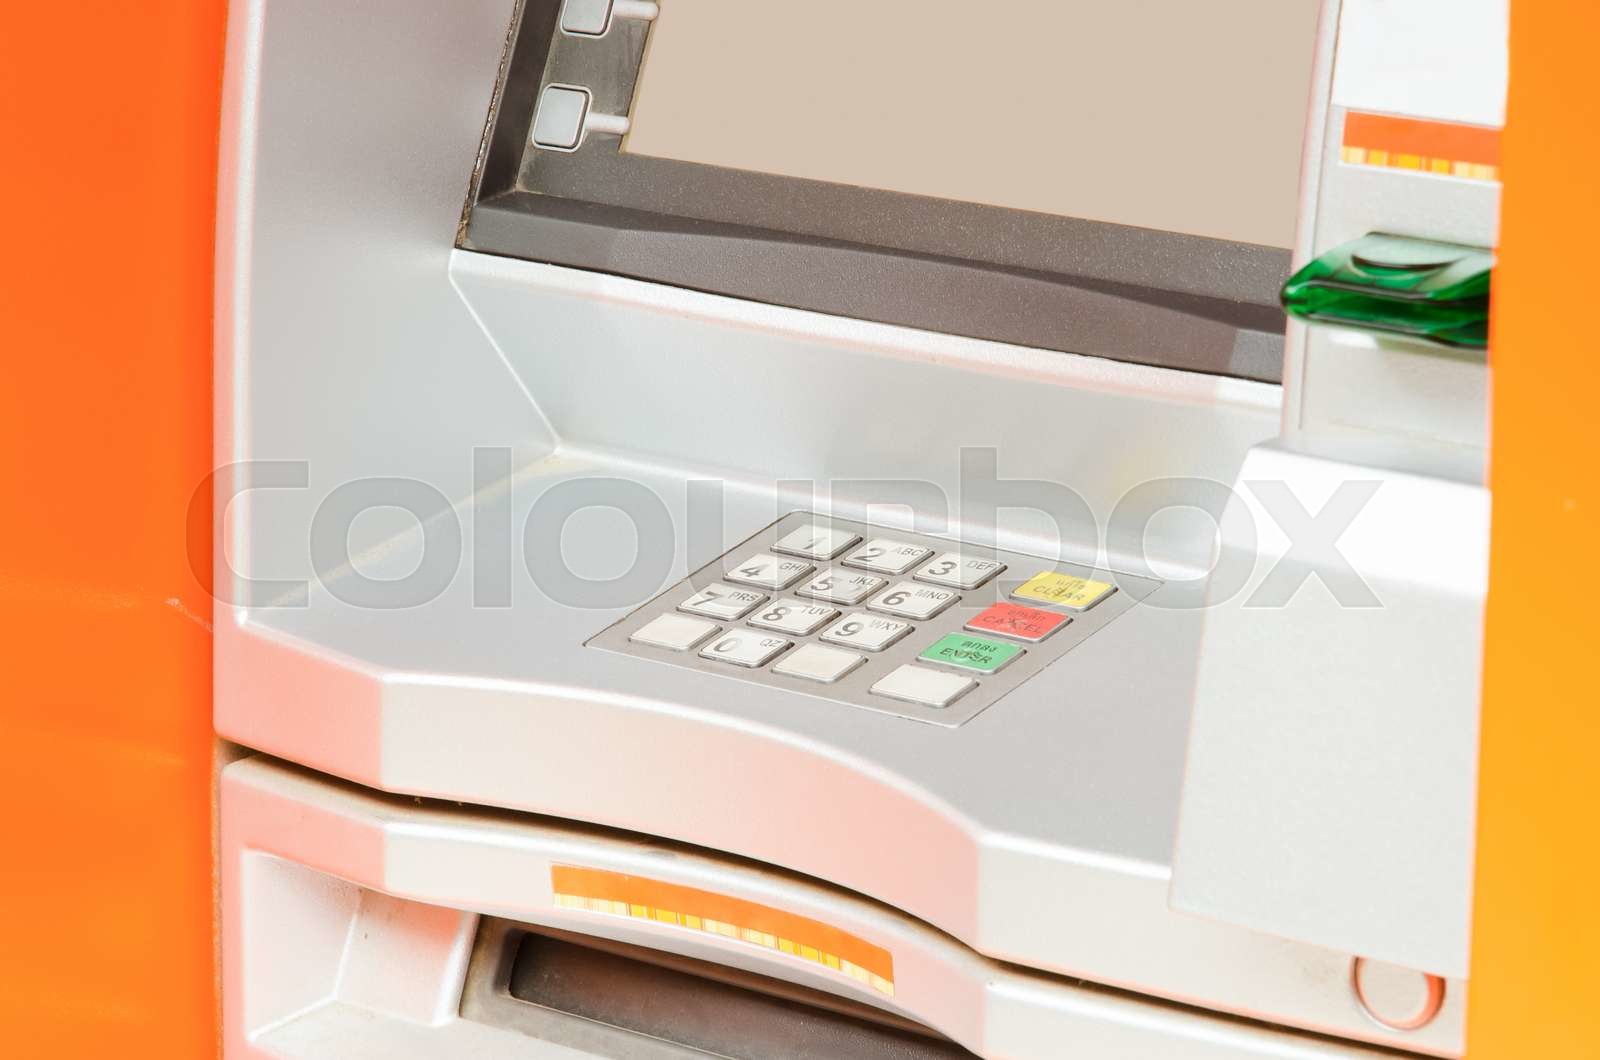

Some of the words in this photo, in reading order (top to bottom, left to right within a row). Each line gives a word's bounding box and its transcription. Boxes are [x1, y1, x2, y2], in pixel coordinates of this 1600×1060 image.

[858, 547, 881, 562] 2
[893, 545, 922, 557] ABC
[739, 561, 764, 577] 4
[778, 561, 805, 572] GHI
[927, 560, 958, 577] 3
[966, 559, 996, 572] DEF
[810, 576, 835, 592] 5
[847, 575, 875, 587] JKL
[691, 591, 719, 607] 7
[728, 591, 760, 603] PRS
[882, 591, 912, 607] 6
[914, 588, 950, 601] MNO
[762, 606, 792, 622] 8
[800, 605, 829, 616] TUV
[834, 621, 865, 637] 9
[869, 619, 903, 632] WXY
[758, 637, 781, 649] QZ
[939, 648, 993, 664] ENTER
